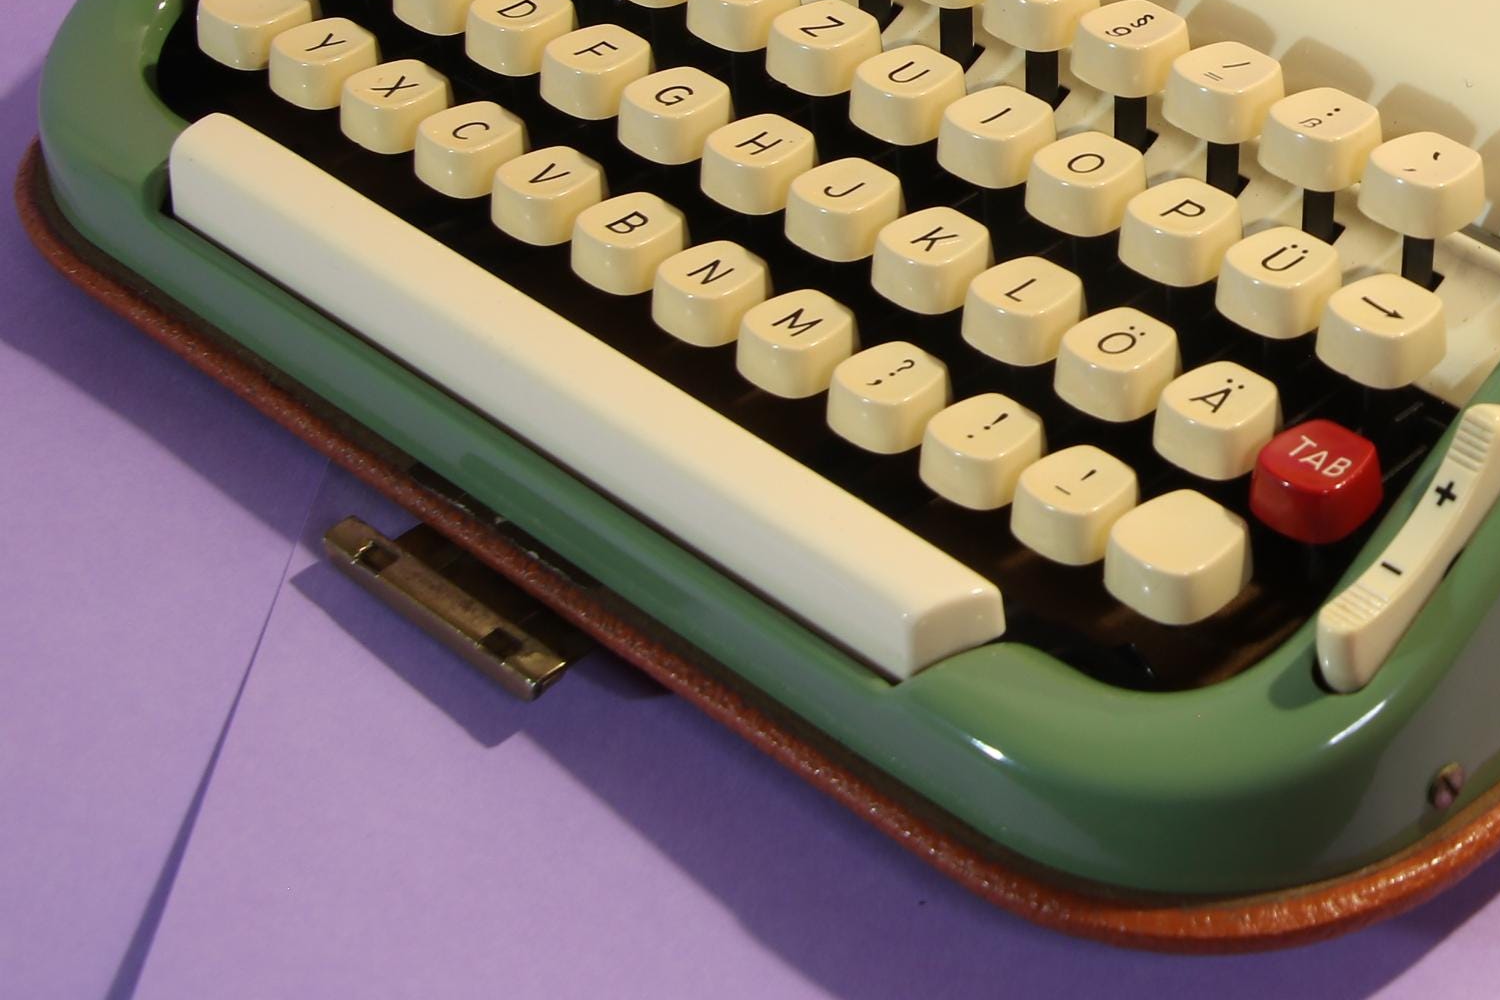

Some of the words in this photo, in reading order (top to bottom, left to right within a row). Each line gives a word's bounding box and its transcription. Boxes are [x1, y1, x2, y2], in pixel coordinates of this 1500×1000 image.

[799, 15, 845, 38] Z
[1105, 26, 1133, 37] 9
[1130, 14, 1155, 28] §
[305, 32, 347, 53] Y
[572, 40, 618, 57] F
[887, 60, 931, 84] U
[371, 75, 419, 99] X
[654, 85, 694, 107] G
[980, 107, 1012, 125] I
[452, 121, 490, 141] C
[734, 130, 783, 156] H
[528, 162, 571, 184] V
[1066, 152, 1106, 174] O
[823, 181, 866, 199] J
[1159, 198, 1206, 218] P
[605, 210, 649, 235] B
[909, 225, 959, 253] K
[1260, 243, 1309, 272] Ü
[686, 258, 735, 286] N
[1004, 278, 1037, 303] L
[771, 307, 824, 338] M
[1097, 325, 1146, 355] Ö
[888, 359, 916, 377] ?
[1189, 376, 1245, 414] Ä
[983, 412, 1009, 431] !
[1288, 435, 1352, 478] TAB
